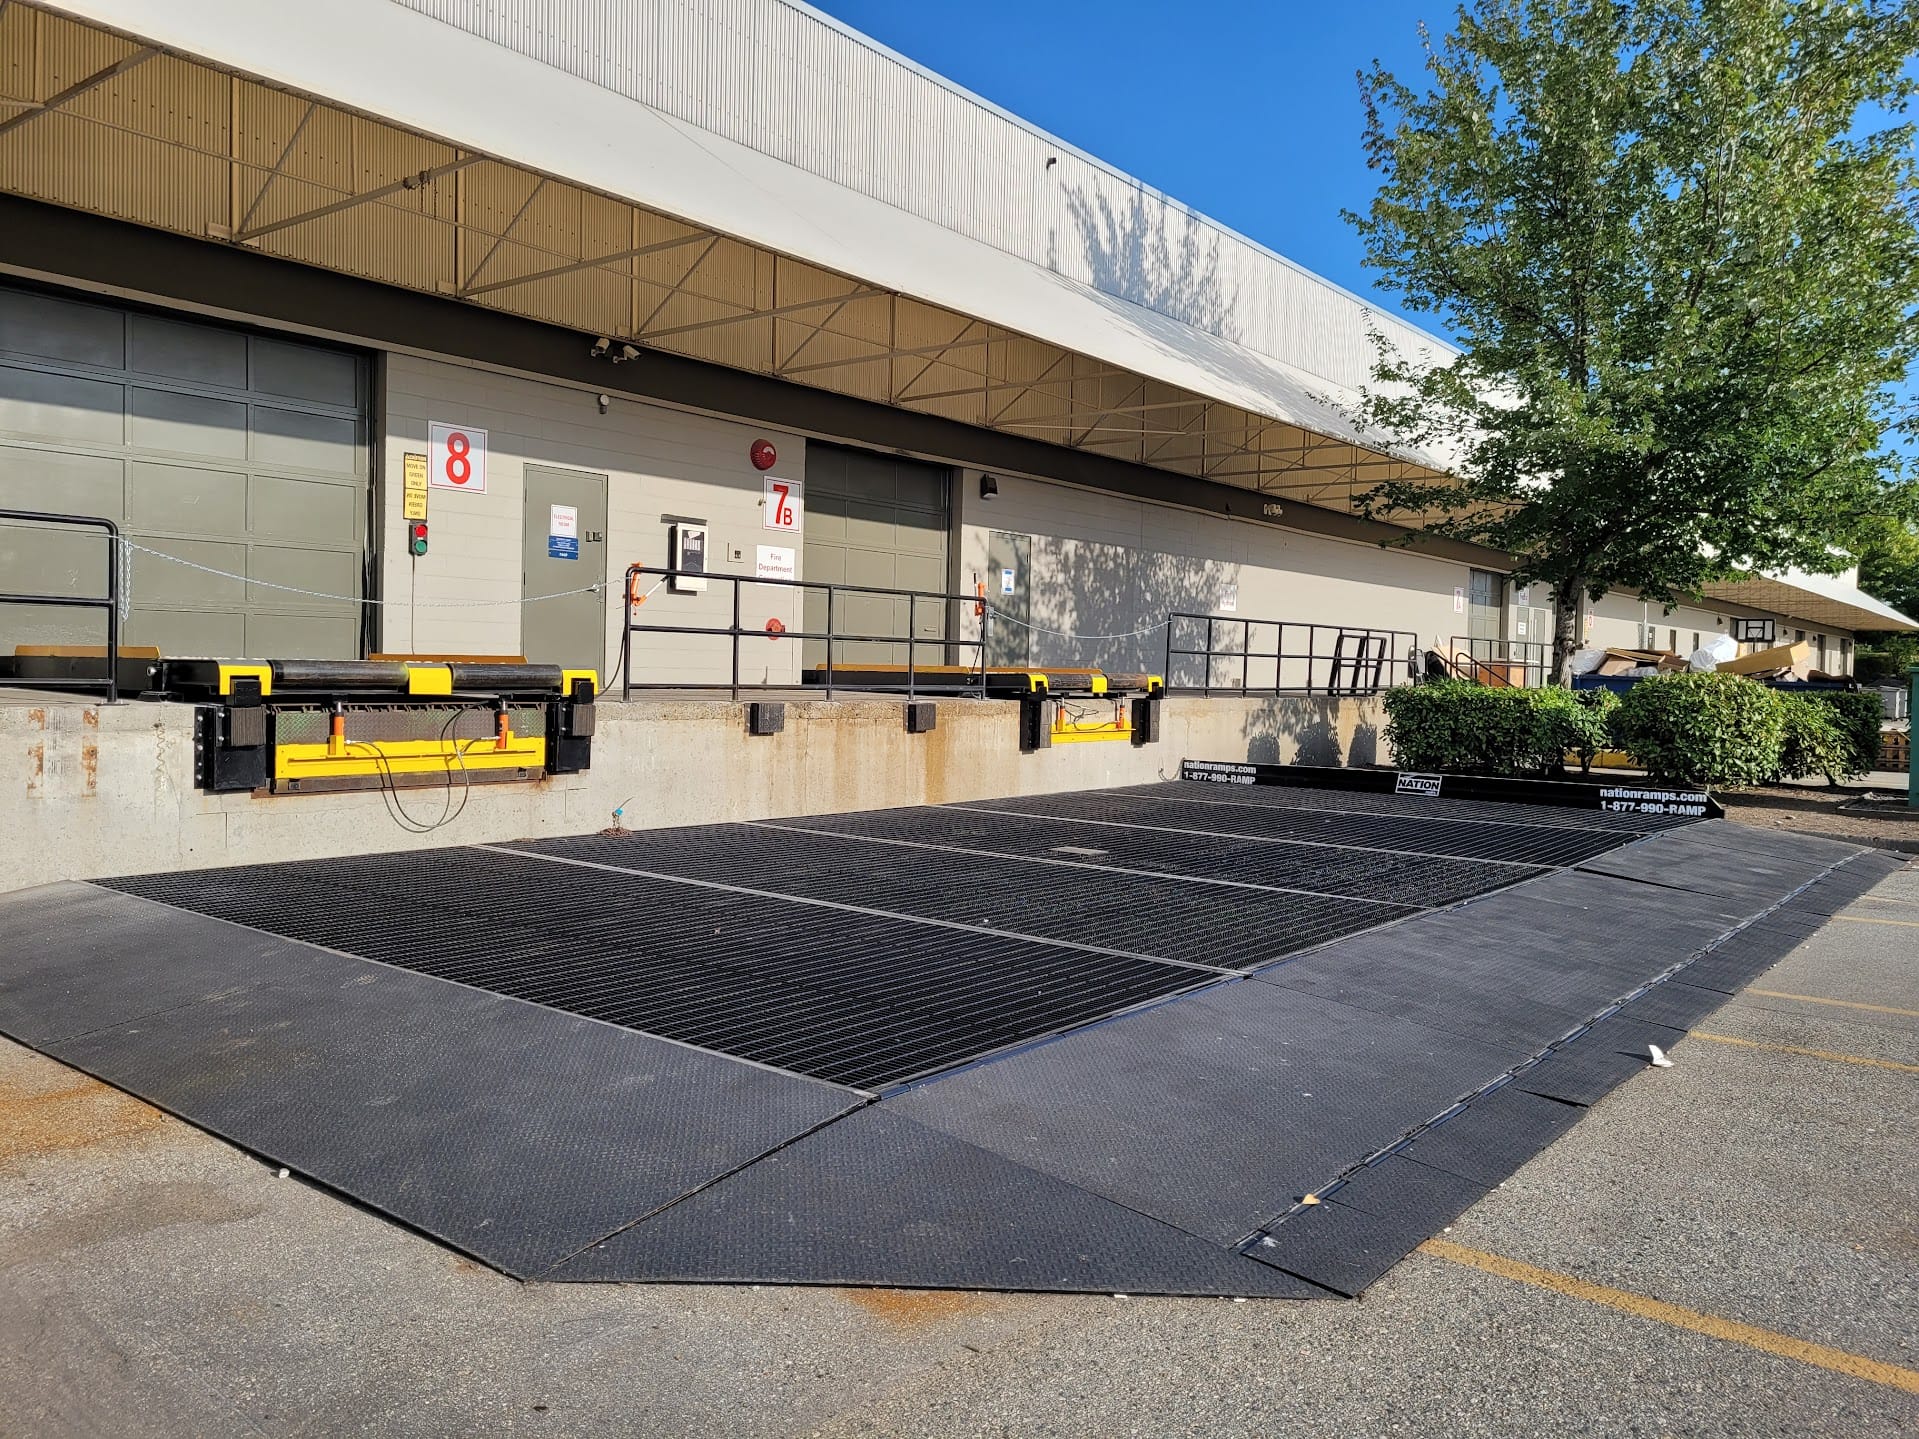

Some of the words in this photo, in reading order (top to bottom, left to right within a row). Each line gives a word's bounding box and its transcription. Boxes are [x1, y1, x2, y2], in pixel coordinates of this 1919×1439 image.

[446, 432, 471, 485] 8
[770, 553, 782, 561] Fire
[758, 562, 793, 574] Department
[1183, 761, 1257, 774] nationramps.com
[1183, 771, 1256, 785] 1-877-990-RAMP
[1398, 779, 1440, 790] NATION
[1600, 788, 1708, 802] nationramps.com
[1600, 801, 1707, 816] 1-877-990-RAMP
